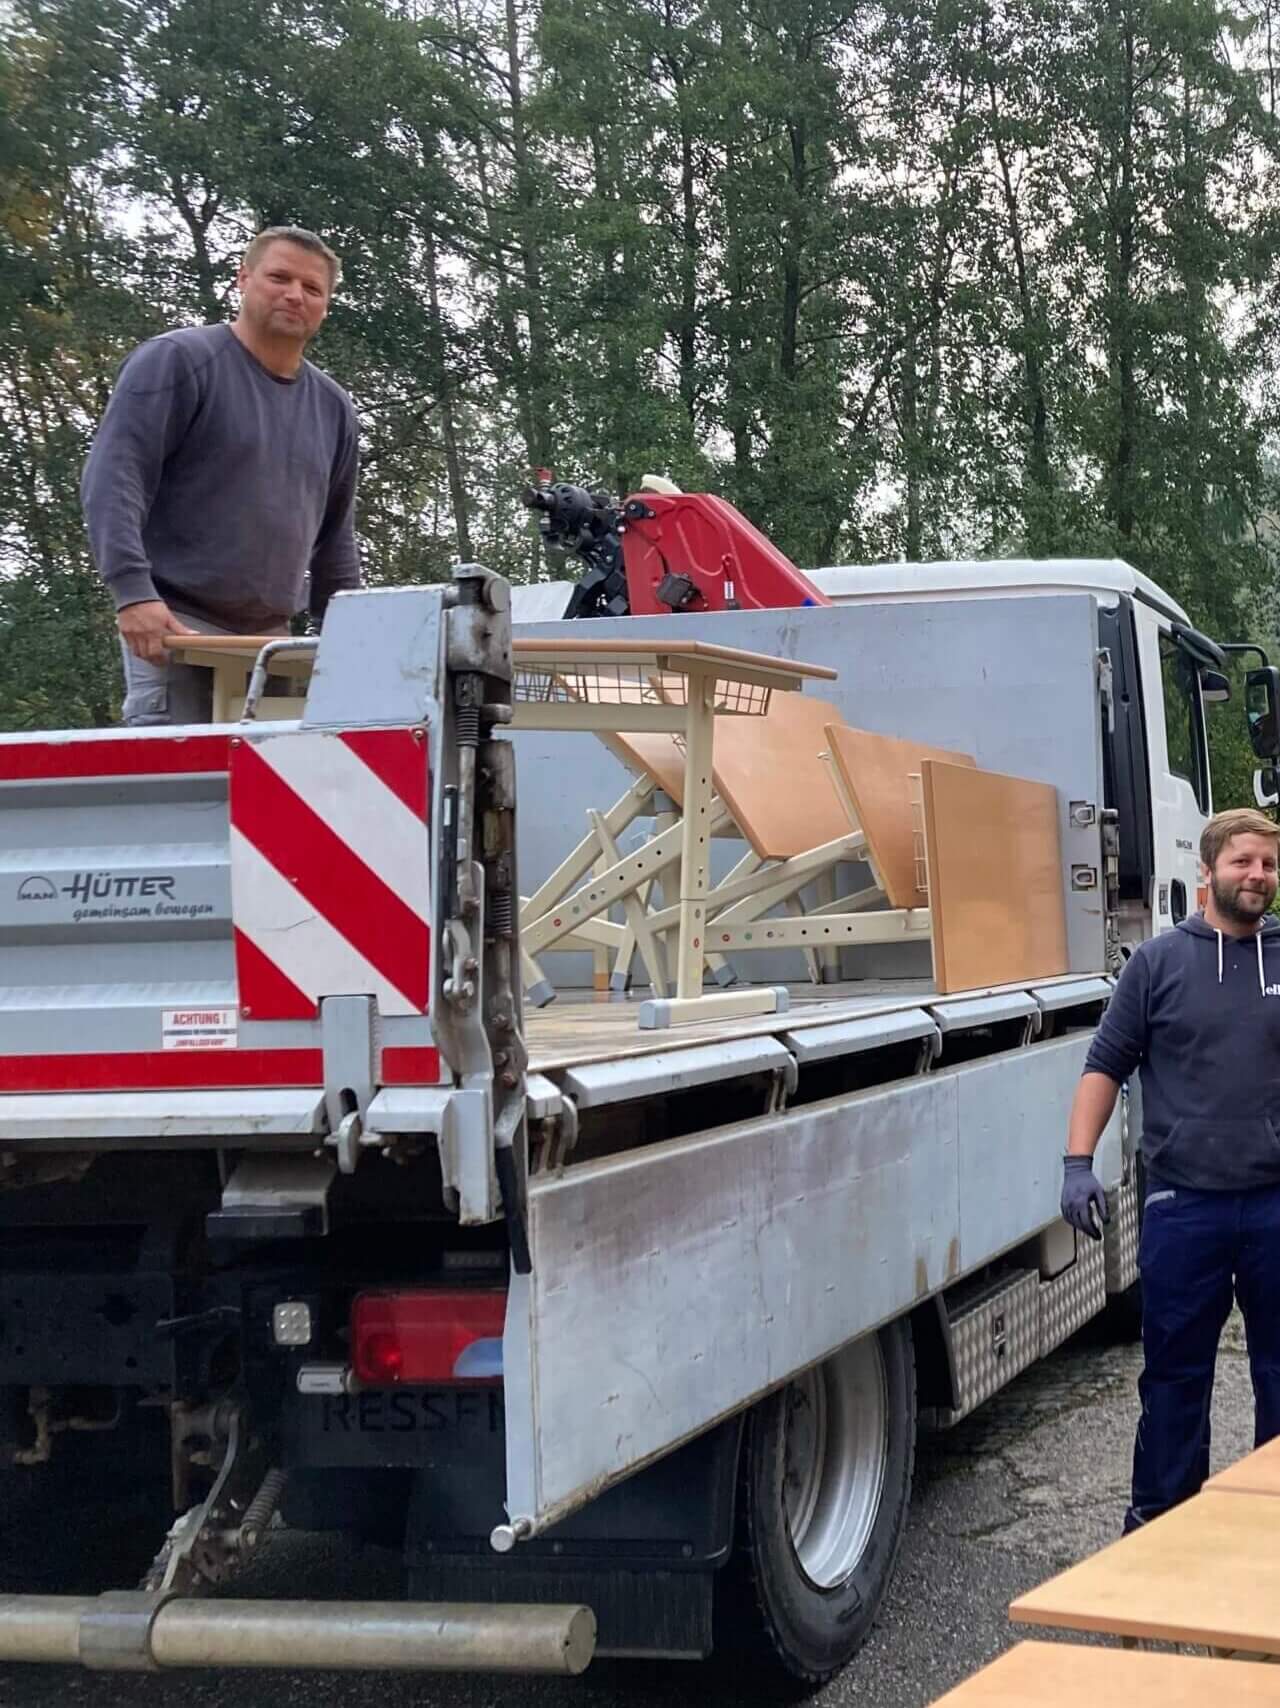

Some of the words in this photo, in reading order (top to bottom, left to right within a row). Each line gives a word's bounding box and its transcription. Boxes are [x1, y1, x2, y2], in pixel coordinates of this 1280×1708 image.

[61, 872, 176, 903] HÜTTER
[72, 904, 152, 922] gemeinsam
[154, 901, 214, 917] bewegen
[173, 1012, 220, 1025] ACHTUNG
